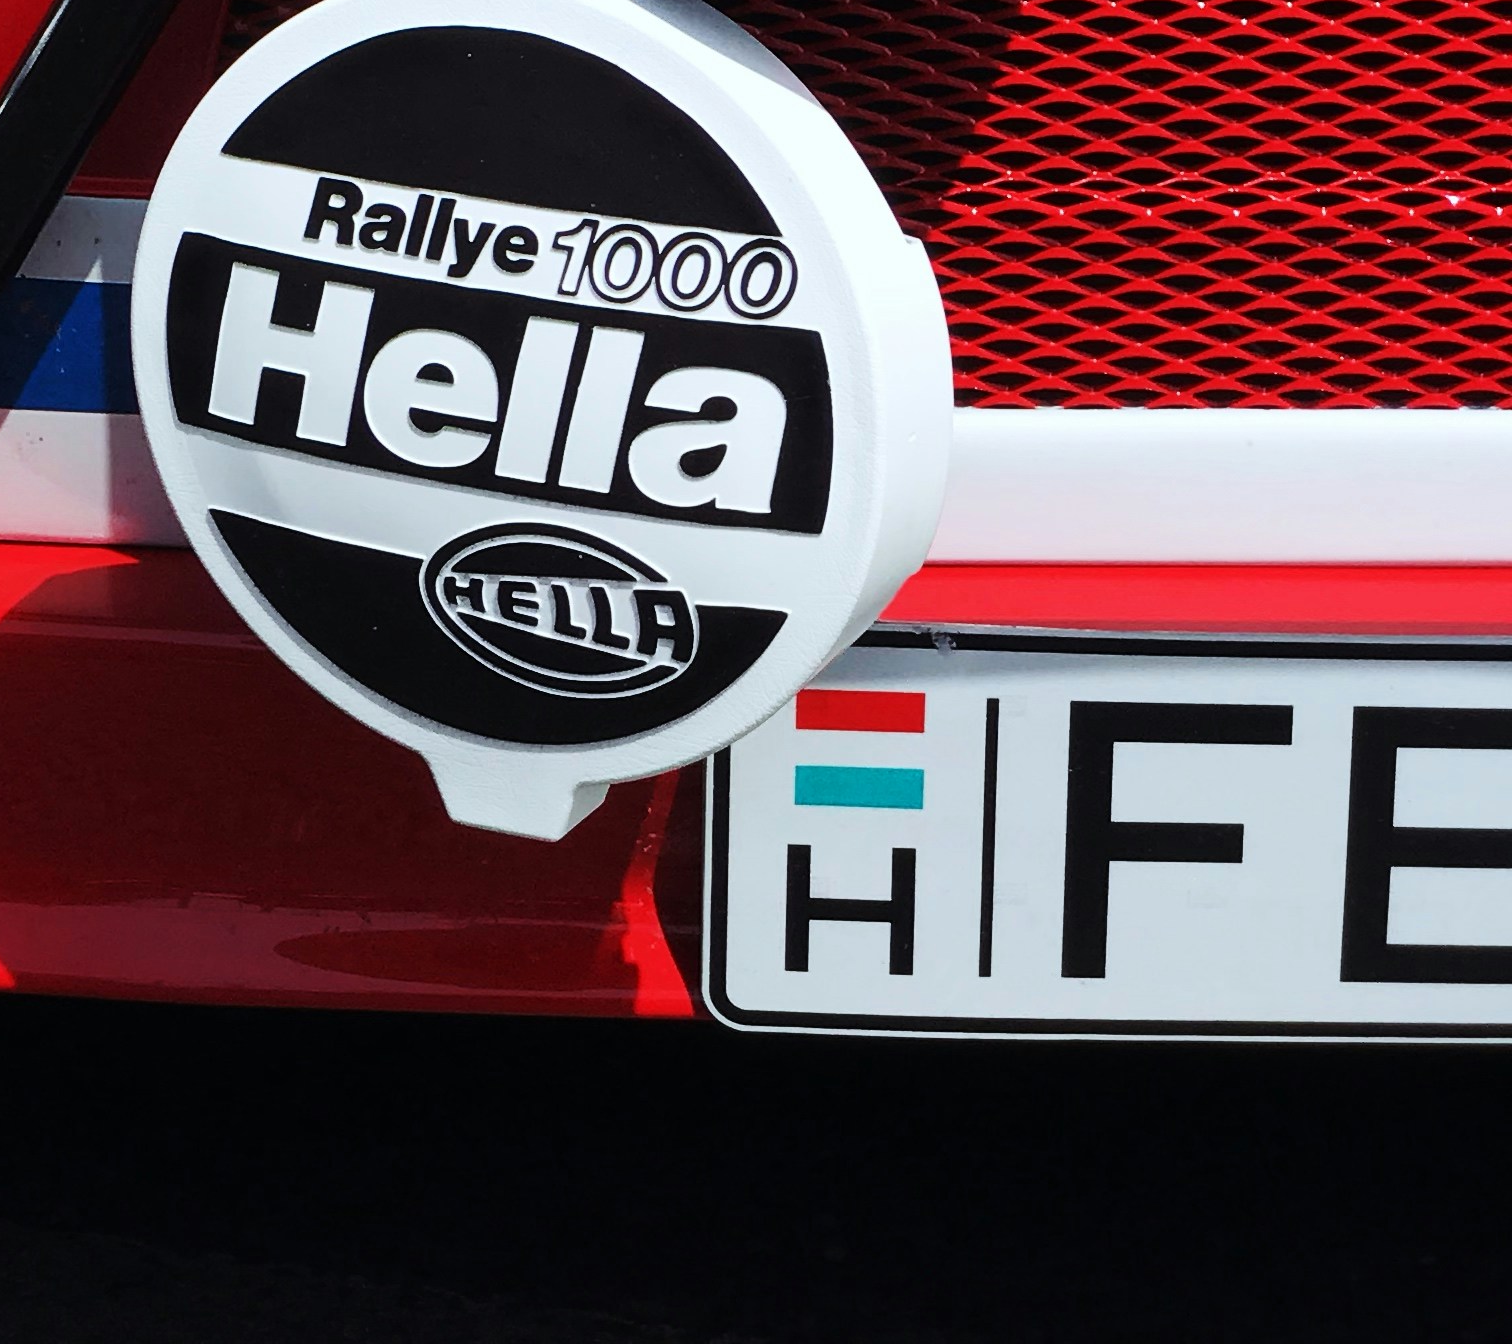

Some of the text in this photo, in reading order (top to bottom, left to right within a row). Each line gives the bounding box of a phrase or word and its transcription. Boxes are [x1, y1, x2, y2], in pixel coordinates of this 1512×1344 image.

[304, 177, 798, 320] Rallye 1000
[207, 264, 787, 513] Hella
[446, 575, 695, 663] HELLA
[785, 701, 1512, 982] H FE
